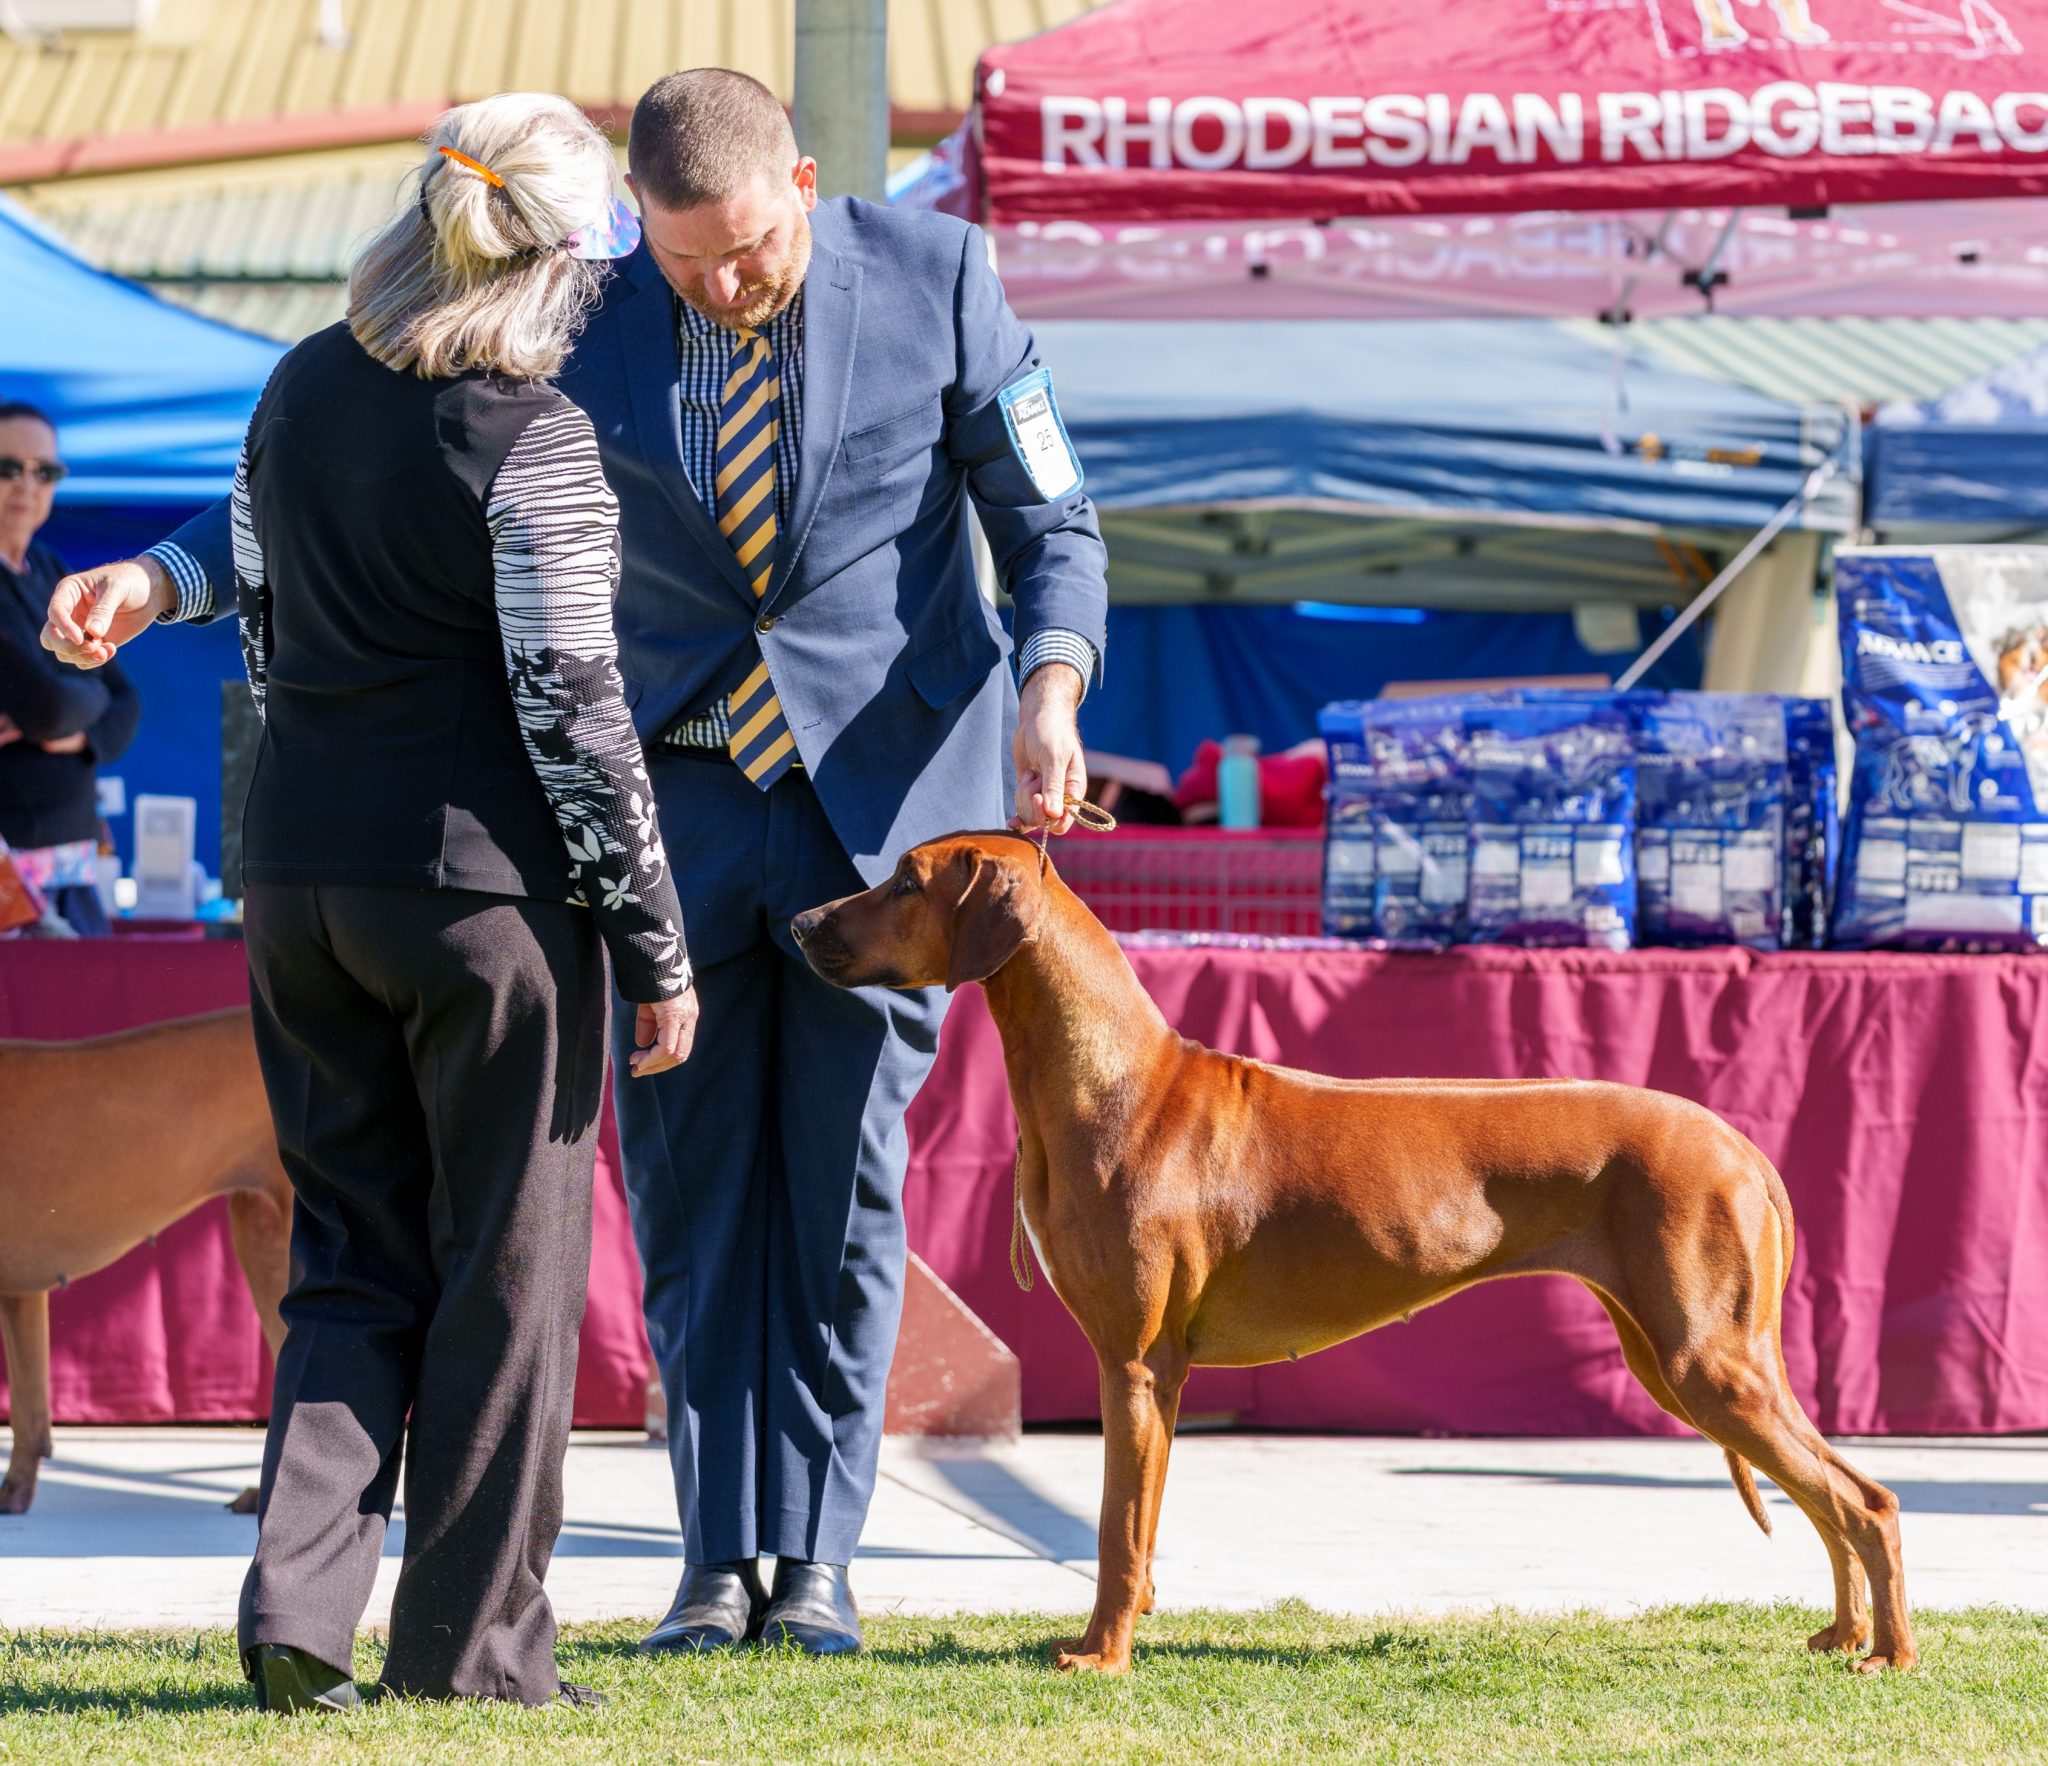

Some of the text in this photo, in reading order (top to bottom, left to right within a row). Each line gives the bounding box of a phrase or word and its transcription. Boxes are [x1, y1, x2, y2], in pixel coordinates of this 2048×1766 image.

[1039, 80, 2048, 175] RHODESIAN RIDGEBAC
[1036, 428, 1055, 452] 25
